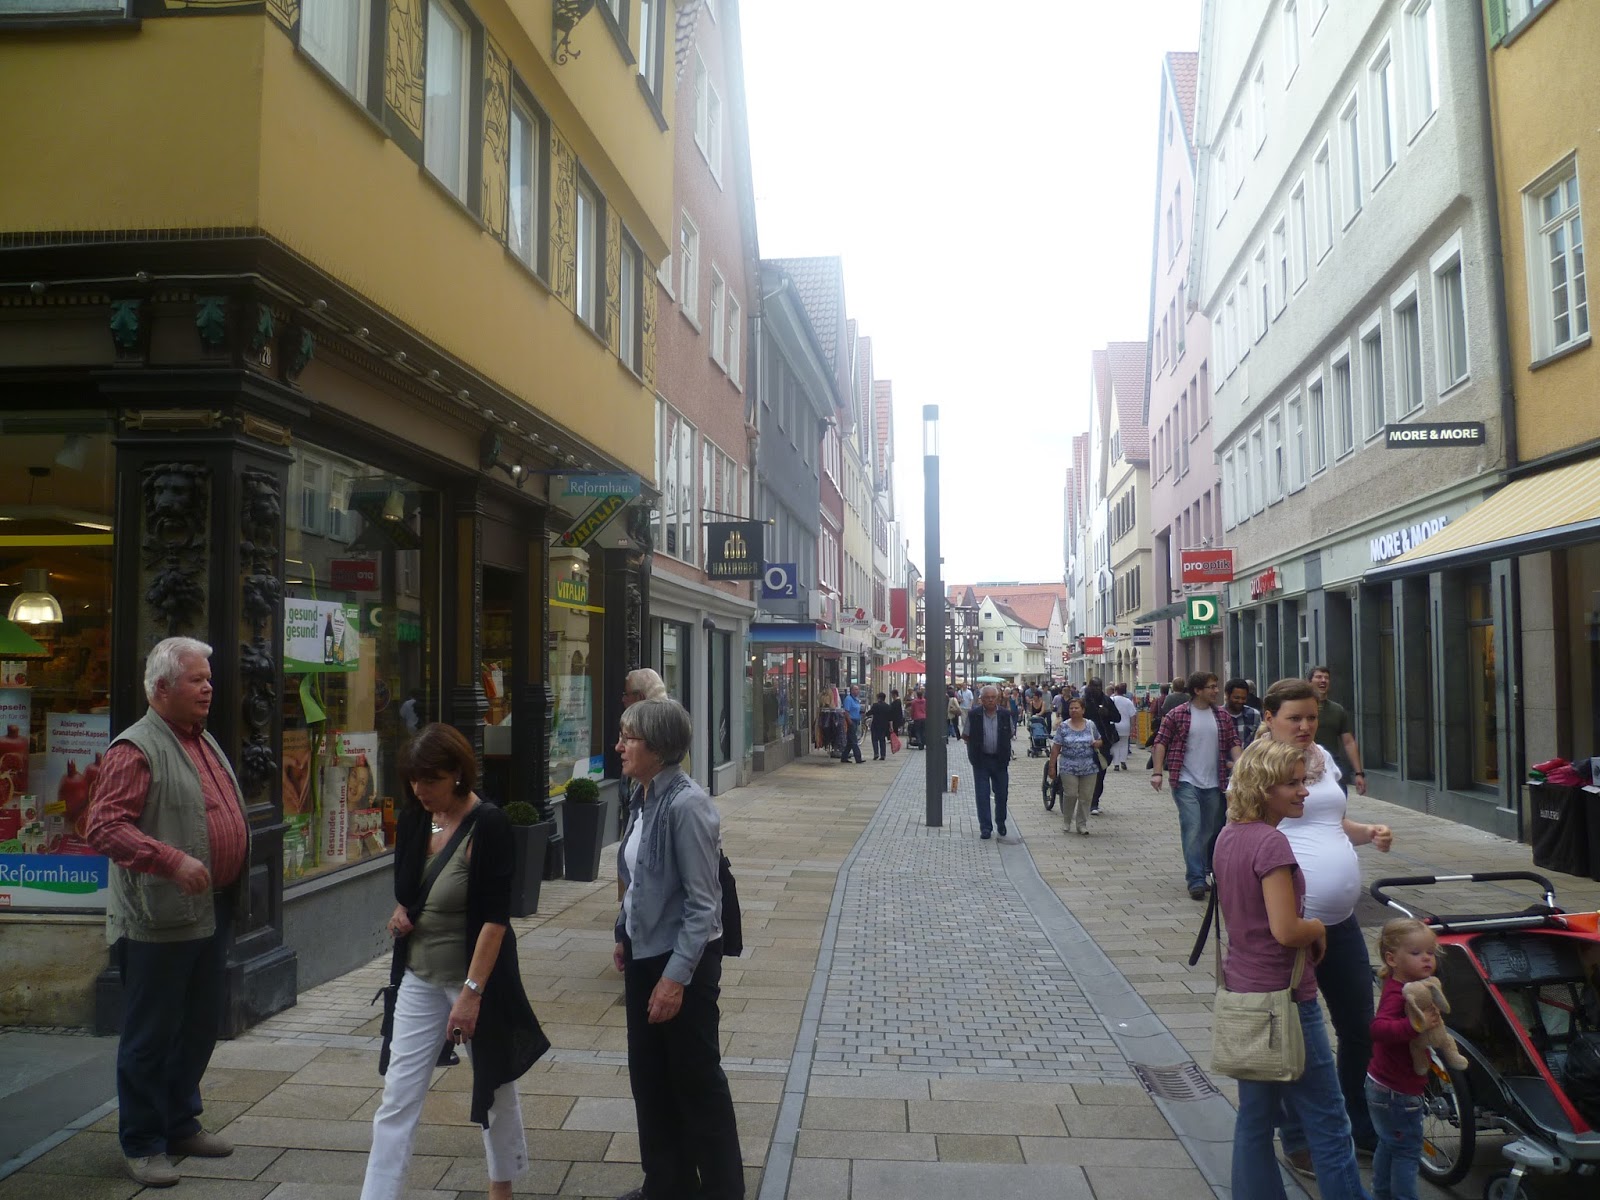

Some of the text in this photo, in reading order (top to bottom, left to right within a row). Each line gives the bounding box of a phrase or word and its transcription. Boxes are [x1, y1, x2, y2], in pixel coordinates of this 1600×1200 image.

[1389, 428, 1478, 441] MORE & MORE
[570, 481, 634, 496] Reformhaus
[565, 496, 622, 548] VITALIA
[1370, 530, 1401, 562] MORE
[1401, 528, 1410, 550] &
[557, 580, 586, 602] VITALIA
[288, 606, 318, 623] gesund
[1191, 600, 1214, 621] D
[286, 623, 318, 641] gesund!
[337, 785, 346, 856] Haarwachstum
[327, 810, 336, 857] Gesundes
[0, 863, 98, 887] Reformhaus
